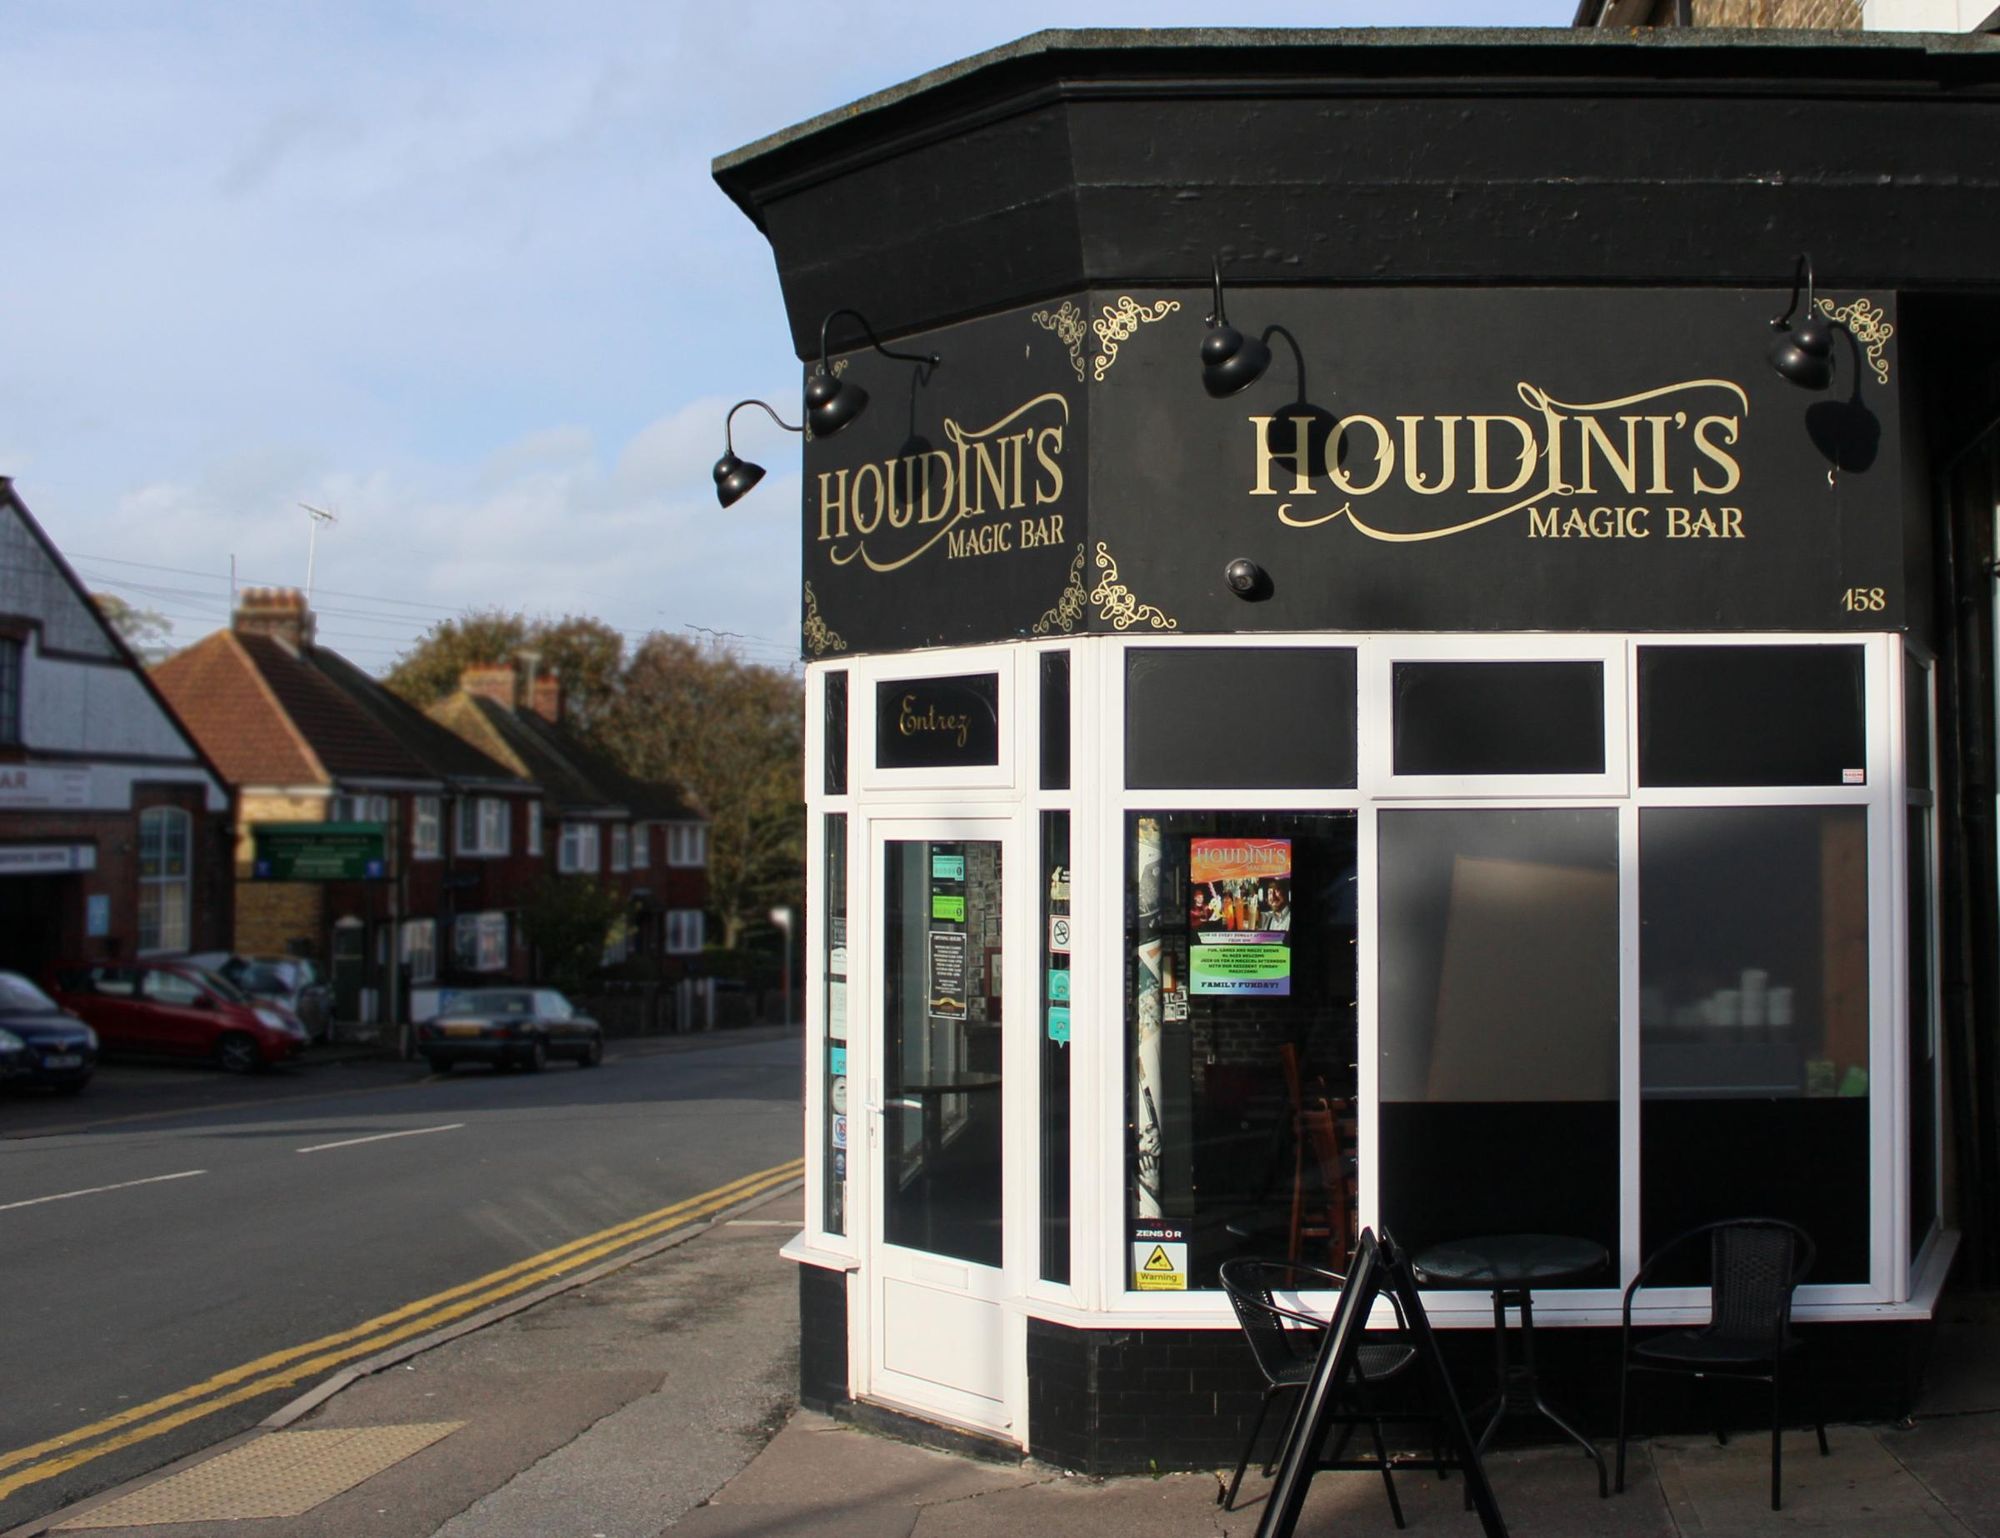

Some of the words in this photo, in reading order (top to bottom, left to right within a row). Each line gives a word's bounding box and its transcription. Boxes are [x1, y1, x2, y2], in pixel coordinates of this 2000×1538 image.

[1248, 381, 1748, 506] HOUDINI'S
[817, 400, 1066, 549] HOUDINI'S
[948, 522, 1012, 560] MAGIC
[1020, 514, 1065, 549] BAR
[1527, 507, 1650, 539] MAGIC
[1666, 507, 1745, 539] BAR
[1841, 587, 1886, 612] 158
[899, 694, 968, 748] Entrez
[1196, 845, 1287, 864] HOUDINI'S
[1140, 1272, 1177, 1282] Warning
